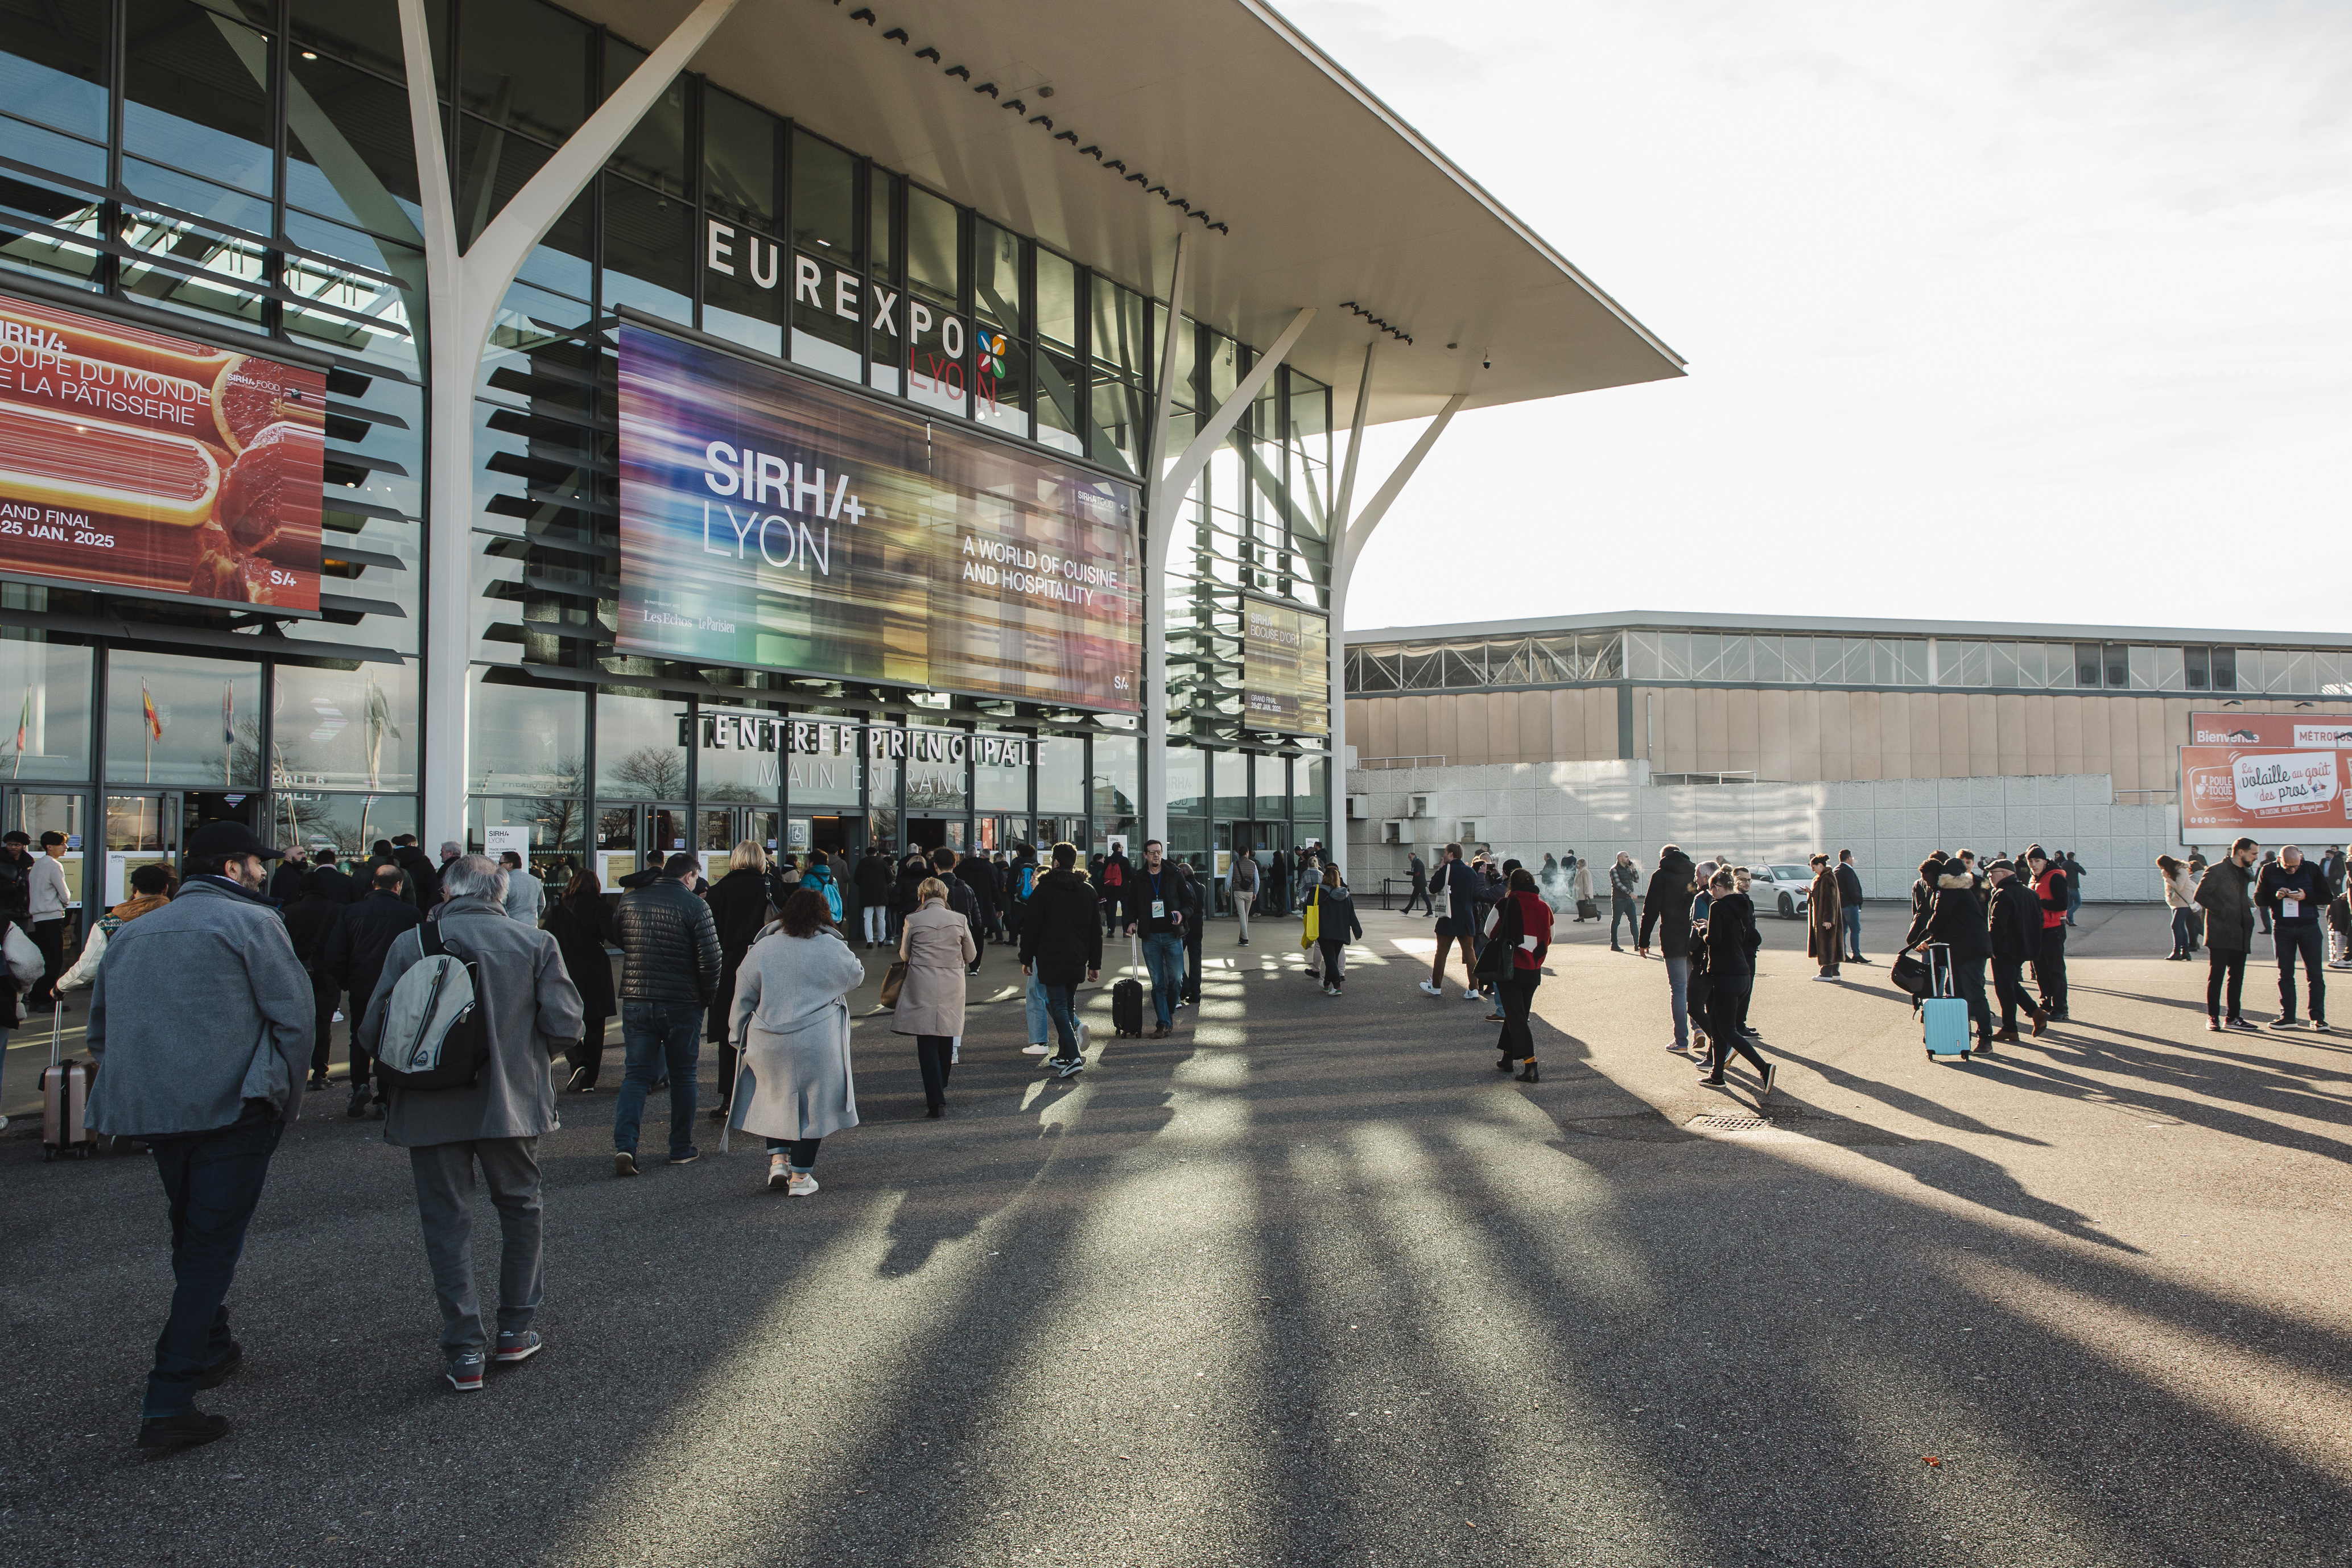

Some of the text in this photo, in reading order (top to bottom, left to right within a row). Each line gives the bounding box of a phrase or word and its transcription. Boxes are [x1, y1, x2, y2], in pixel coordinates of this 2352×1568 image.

[708, 219, 964, 359] EUREXPO
[81, 361, 114, 385] DU
[123, 371, 211, 407] MONDE
[257, 379, 280, 391] FOOD
[910, 346, 996, 412] LYON
[21, 372, 53, 397] LA
[61, 381, 195, 427] PÂTISSERIE
[1097, 496, 1113, 509] FOOD
[46, 509, 94, 530] FINAL
[27, 524, 69, 542] JAN.
[74, 530, 114, 548] 2025
[704, 501, 828, 576] LYON
[963, 535, 1117, 589] A WORLD OF CUISINE
[963, 561, 1094, 606] AND HOSPITALITY
[1251, 624, 1296, 645] BOCUSE D'OR
[1251, 694, 1265, 703] GRAND
[867, 727, 1047, 766] PRINCIPALE
[758, 760, 835, 789] MAIN
[2209, 776, 2233, 786] POULE
[2242, 763, 2253, 774] La
[2242, 762, 2331, 788] volaille au goût
[2209, 786, 2233, 796] TOQUE
[2259, 784, 2309, 803] des pros
